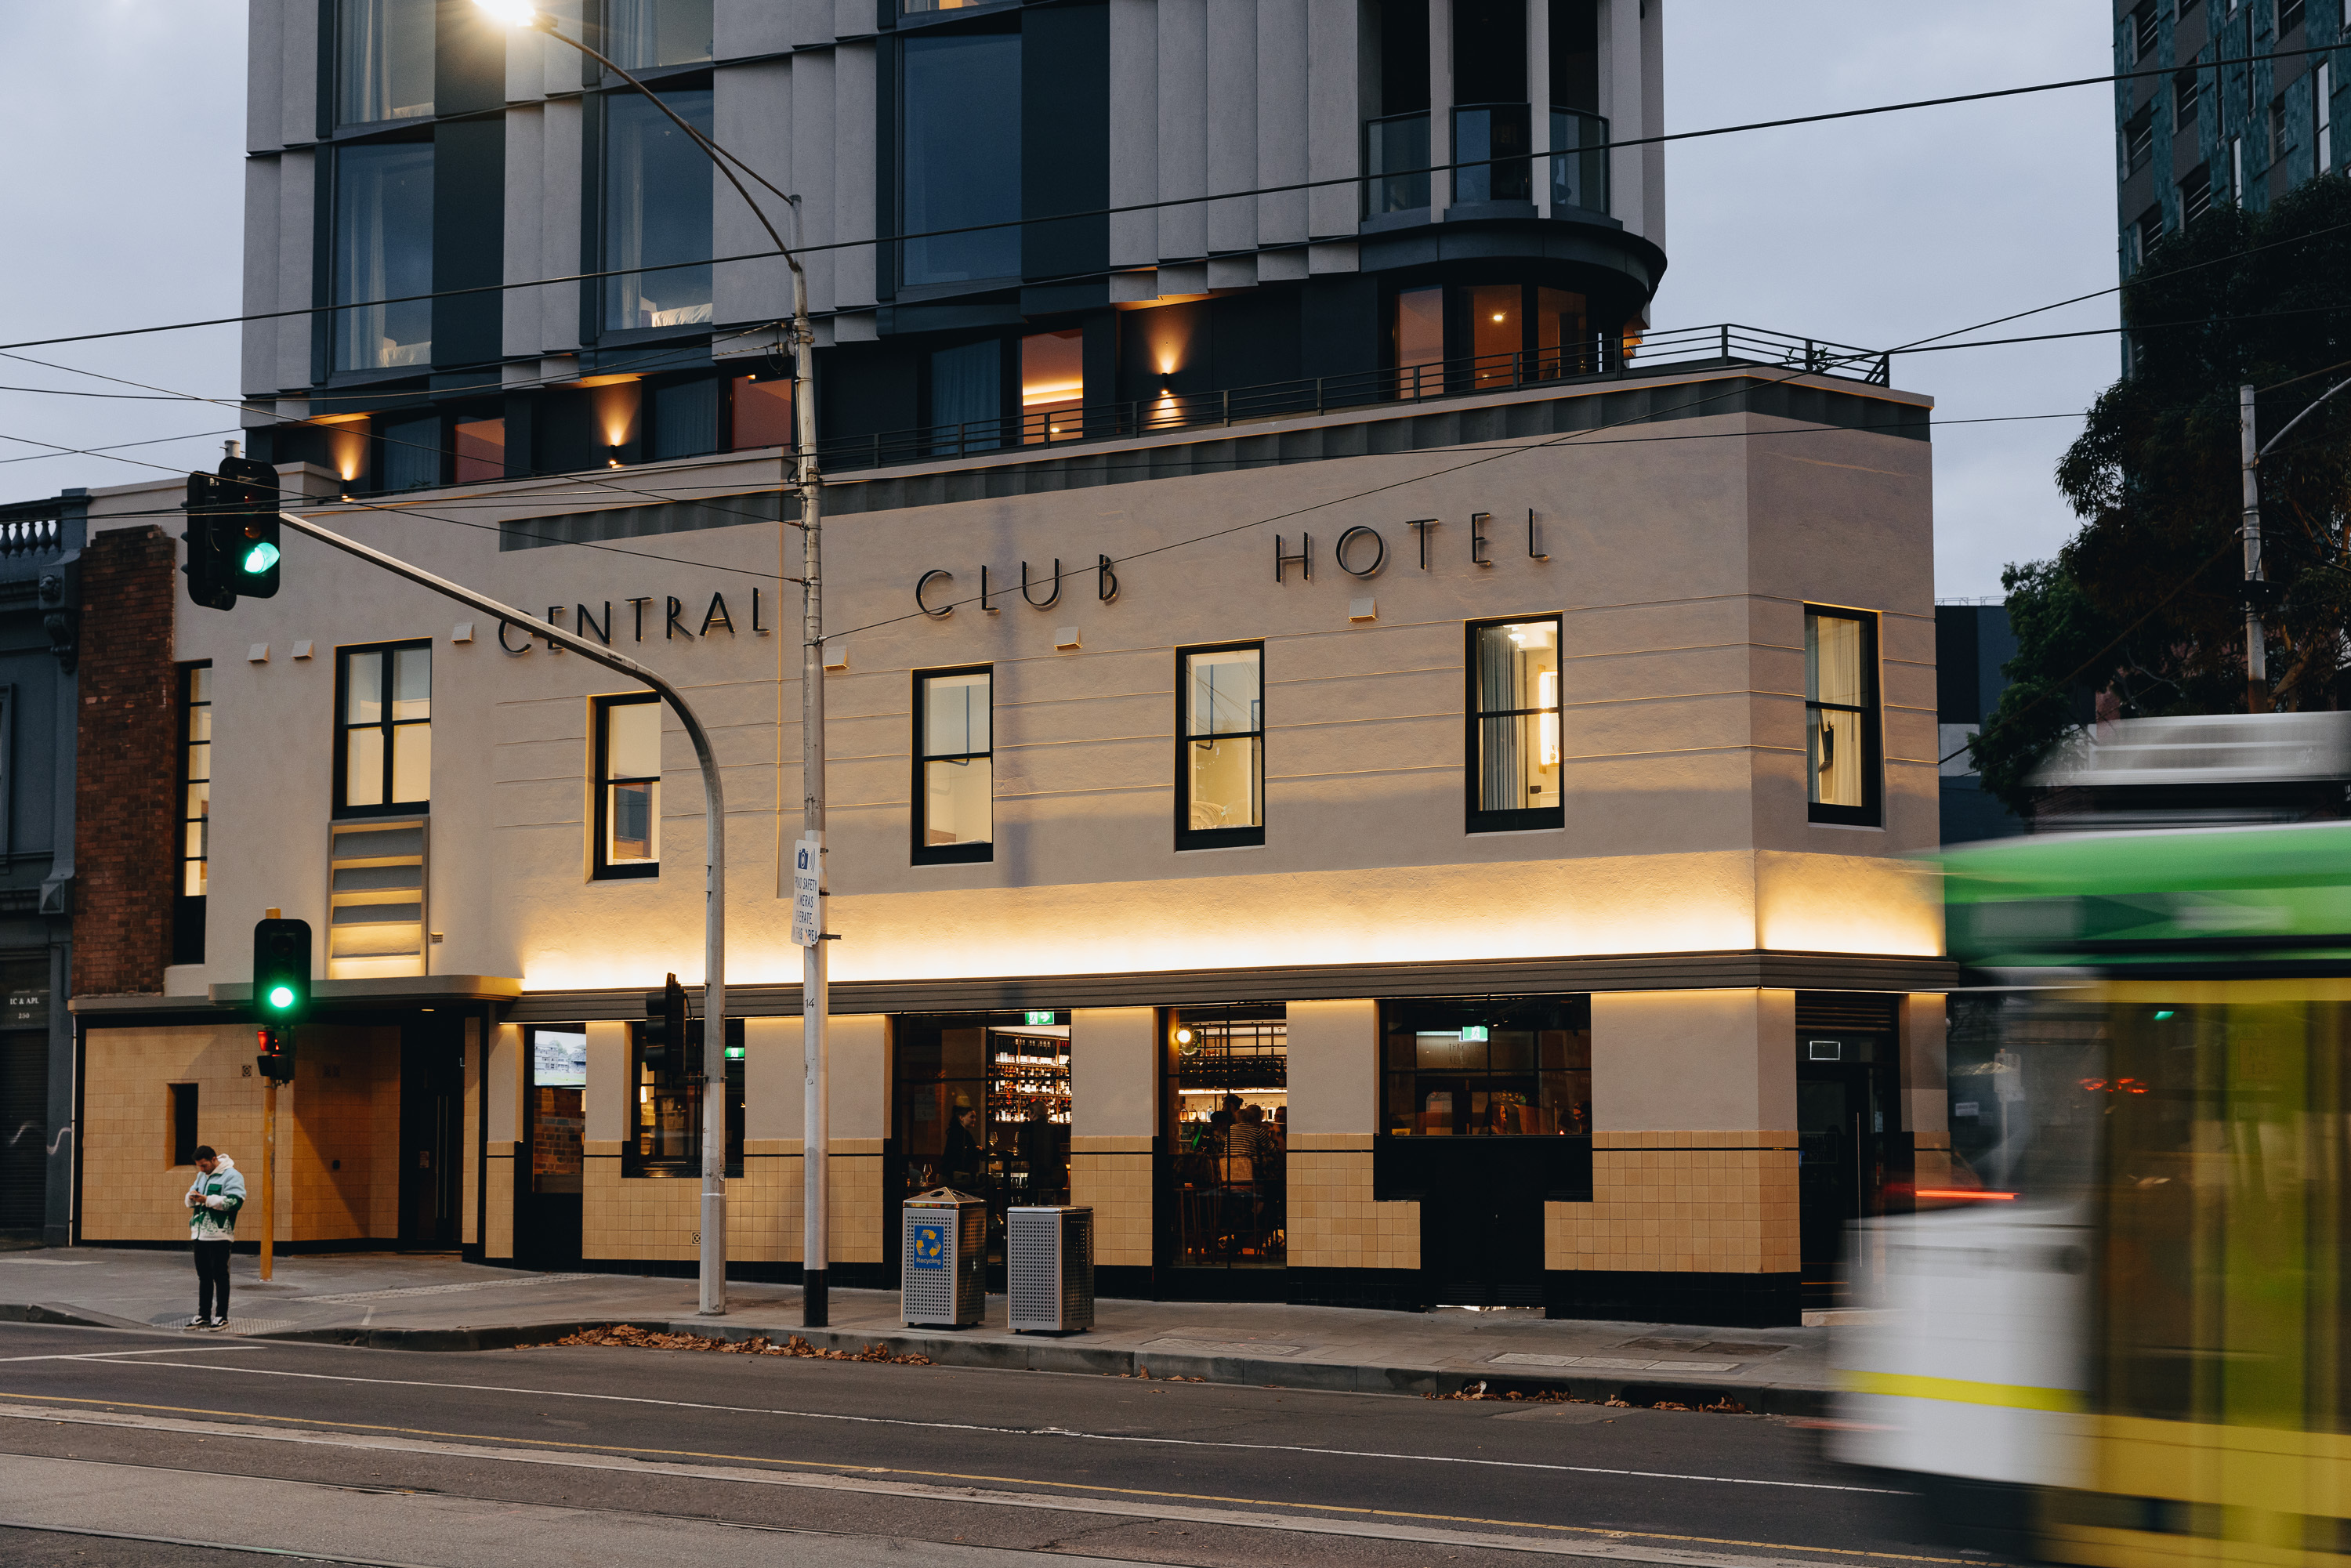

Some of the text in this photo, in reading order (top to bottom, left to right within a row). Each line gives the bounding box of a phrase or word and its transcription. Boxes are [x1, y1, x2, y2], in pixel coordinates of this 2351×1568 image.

[498, 507, 1549, 655] CENTRAL CLUB HOTEL
[802, 878, 817, 891] SAFETY
[805, 998, 814, 1008] 14
[915, 1257, 941, 1266] Recycling
